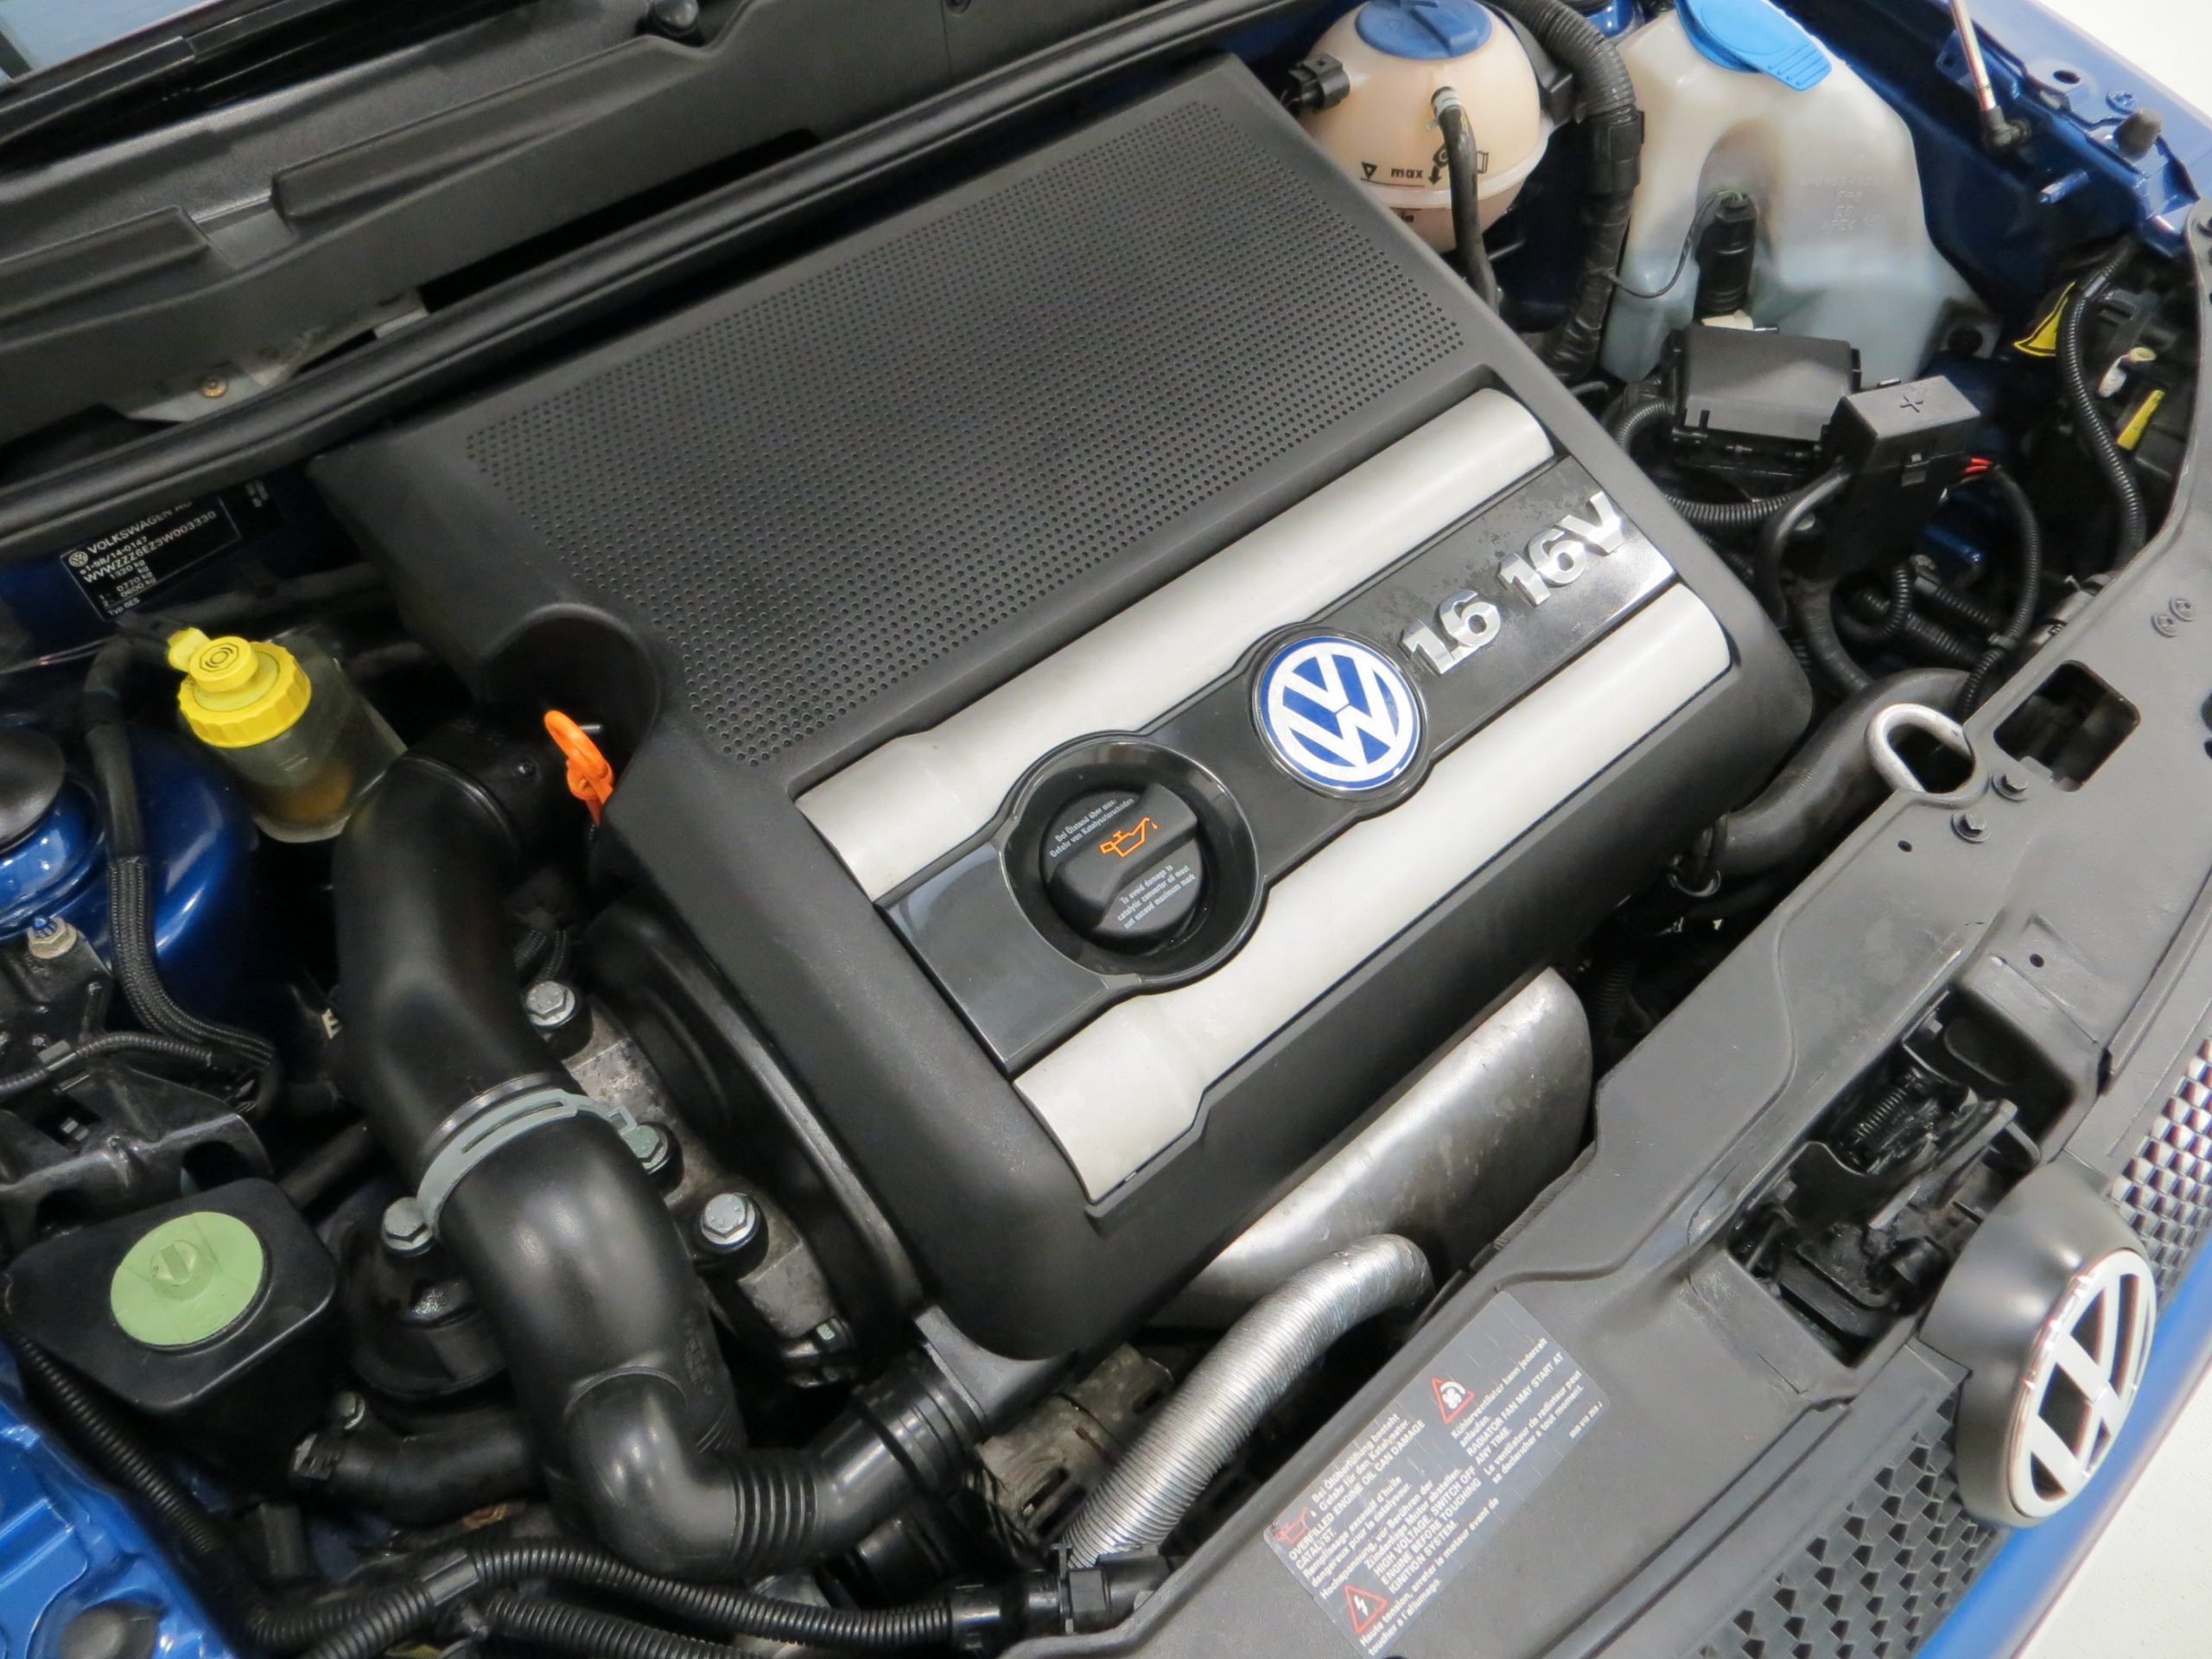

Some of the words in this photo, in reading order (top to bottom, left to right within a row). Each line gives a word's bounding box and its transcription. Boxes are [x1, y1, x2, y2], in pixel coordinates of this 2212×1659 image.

[1391, 168, 1423, 179] max
[87, 512, 171, 553] VOLKSWAGEN
[1496, 490, 1624, 607] 16V
[1050, 841, 1071, 857] Gefahr
[1071, 833, 1083, 842] von
[1118, 900, 1141, 921] catalytic
[1141, 880, 1166, 901] converter
[1175, 866, 1190, 877] must
[1124, 918, 1135, 929] not
[1135, 902, 1154, 920] exceed
[1154, 884, 1181, 905] maximum
[1180, 874, 1196, 886] mark
[1129, 884, 1145, 899] avoid
[1145, 870, 1166, 887] damage
[1451, 1384, 1503, 1439] Kühlerventilator
[1502, 1367, 1521, 1385] kann
[1518, 1338, 1548, 1370] jederzeit
[1466, 1417, 1503, 1456] RADIATOR
[1501, 1402, 1518, 1420] FAN
[1516, 1385, 1532, 1404] MAY
[1531, 1362, 1554, 1388] START
[1554, 1352, 1563, 1364] AT
[1484, 1465, 1495, 1475] Le
[1494, 1427, 1529, 1465] ventilateur
[1529, 1417, 1539, 1428] de
[1538, 1387, 1567, 1419] radiateur
[1566, 1370, 1581, 1389] peut
[1312, 1487, 1327, 1503] Bei
[1324, 1441, 1374, 1490] Ölüberfüllung
[1370, 1414, 1400, 1442] besteht
[1319, 1484, 1344, 1510] Gefahr
[1344, 1473, 1356, 1486] für
[1356, 1459, 1370, 1475] den
[1368, 1420, 1409, 1460] Katalysator.
[1460, 1416, 1491, 1447] anlaufen.
[1476, 1445, 1491, 1465] ANY
[1491, 1427, 1511, 1446] TIME.
[1492, 1473, 1502, 1484] se
[1541, 1414, 1556, 1430] tout
[1555, 1385, 1583, 1416] moment.
[1289, 1513, 1334, 1560] OVERFILLED
[1333, 1483, 1363, 1515] ENGINE
[1362, 1471, 1376, 1484] OIL
[1375, 1452, 1393, 1471] CAN
[1391, 1420, 1425, 1455] DAMAGE
[1364, 1524, 1410, 1569] Zündanlage
[1405, 1501, 1429, 1526] Motor
[1429, 1469, 1462, 1503] abstellen.
[1374, 1552, 1395, 1576] HIGH
[1431, 1482, 1462, 1516] SWITCH
[1460, 1465, 1475, 1484] OFF
[1376, 1528, 1388, 1541] vor
[1387, 1494, 1421, 1529] Berühren
[1421, 1481, 1433, 1495] der
[1296, 1528, 1336, 1569] CATALYST.
[1303, 1531, 1349, 1579] Remplissage
[1349, 1499, 1377, 1533] excessif
[1312, 1547, 1350, 1587] dangereux
[1349, 1529, 1367, 1549] pour
[1364, 1521, 1375, 1529] le
[1382, 1550, 1412, 1585] ENGINE
[1411, 1520, 1442, 1553] BEFORE
[1440, 1478, 1481, 1521] TOUCHING
[1389, 1554, 1426, 1593] IGNITION
[1424, 1521, 1459, 1555] SYSTEM.
[1360, 1622, 1383, 1646] Haute
[1434, 1557, 1444, 1567] le
[1443, 1529, 1469, 1558] moteur
[1469, 1508, 1490, 1530] avant
[1489, 1498, 1498, 1509] de
[1369, 1624, 1397, 1656] toucher
